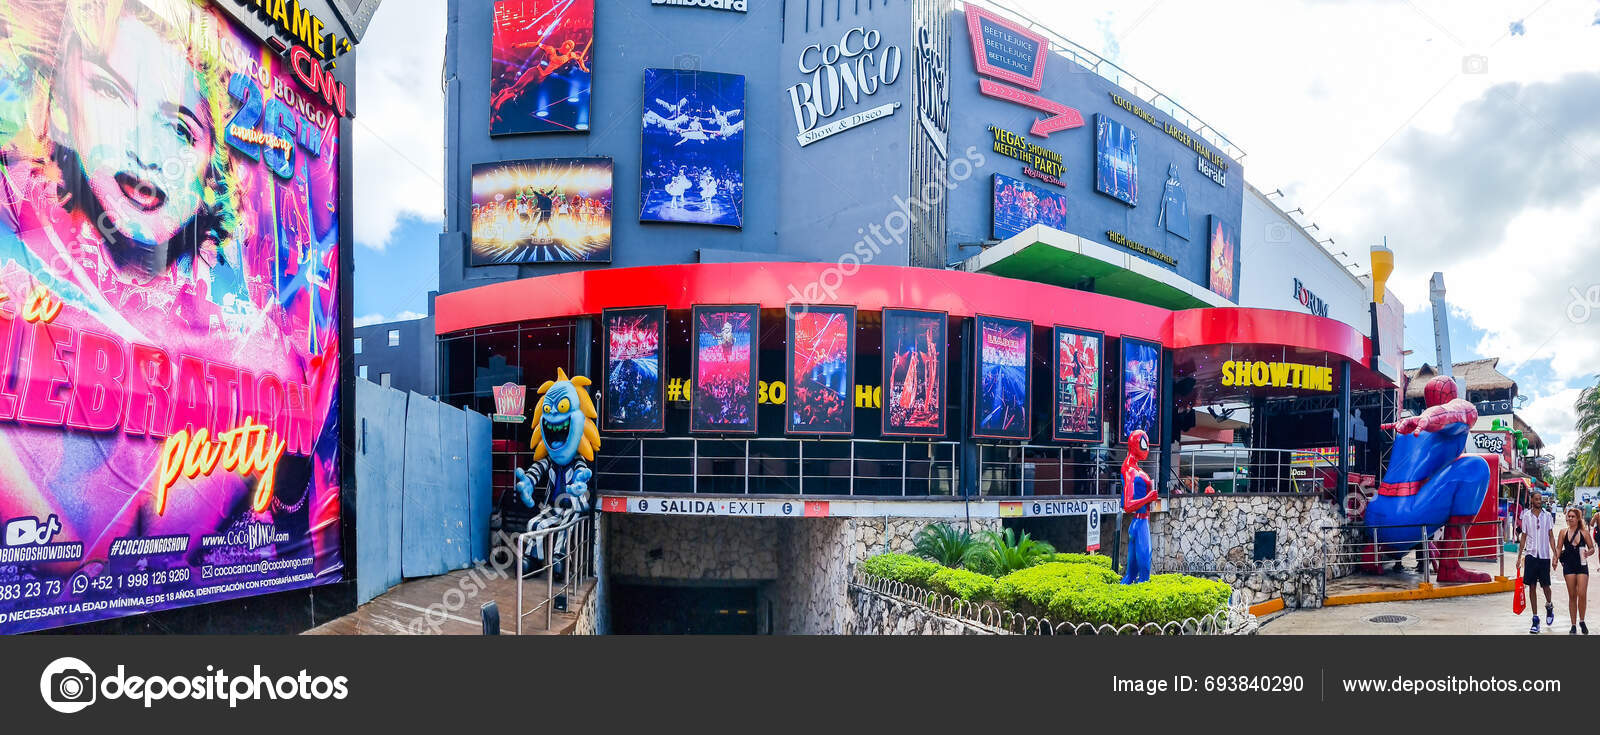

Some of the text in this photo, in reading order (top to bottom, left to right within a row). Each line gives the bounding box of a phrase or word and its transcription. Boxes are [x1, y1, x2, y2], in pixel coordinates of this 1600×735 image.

[291, 45, 346, 117] CNN
[786, 45, 902, 135] BONGO
[273, 76, 327, 129] BONGO
[804, 109, 883, 143] Show & Disco
[1164, 121, 1191, 147] LARGER
[1193, 139, 1211, 160] THAN
[230, 122, 294, 162] anniversary
[994, 141, 1018, 158] MEETS
[1019, 150, 1032, 164] THE
[1028, 143, 1062, 164] SHOWTIME
[1198, 156, 1226, 187] Herald
[22, 283, 63, 324] a
[1293, 277, 1329, 318] FORUM
[1221, 360, 1333, 392] SHOWTIME
[1474, 433, 1504, 453] Frog's
[157, 416, 287, 516] party
[660, 500, 765, 514] SALIDA EXIT
[1045, 501, 1091, 514] ENTRAD
[0, 545, 82, 562] BONGOSHOWDISCO
[110, 537, 189, 556] #COCOBONGOSHOW
[91, 568, 190, 591] +52 1 998 126 9260
[214, 557, 314, 577] cococancun@cocobongo.com
[8, 605, 67, 622] NECESSARY.
[69, 603, 81, 614] LA
[82, 601, 108, 612] EDAD
[109, 597, 145, 609] MÍNIMA
[145, 596, 155, 605] ES
[155, 593, 165, 603] DE
[166, 592, 175, 601] 18
[196, 581, 245, 597] IDENTIFICACIÓN
[246, 579, 260, 589] CON
[24, 582, 41, 598] 23
[45, 580, 61, 595] 73
